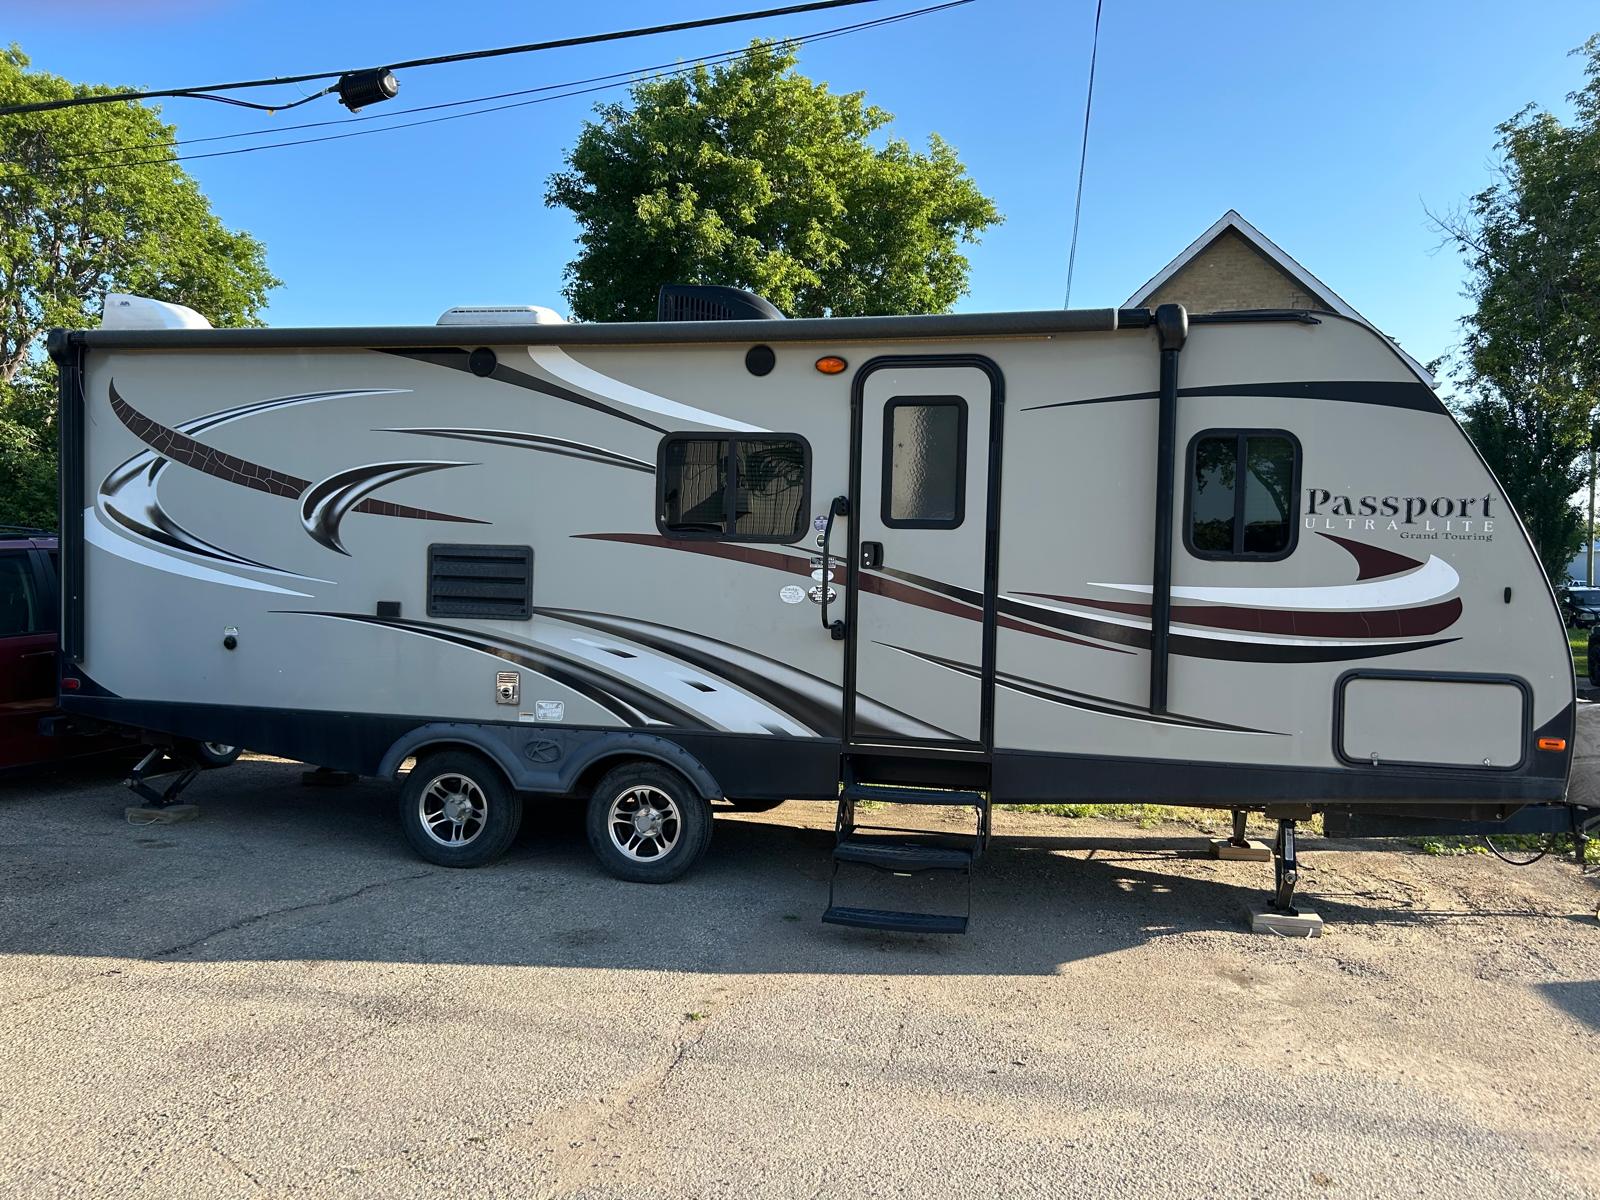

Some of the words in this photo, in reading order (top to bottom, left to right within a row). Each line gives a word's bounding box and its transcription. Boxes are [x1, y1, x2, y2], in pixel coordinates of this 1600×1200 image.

[1304, 488, 1497, 524] Passport
[1304, 518, 1398, 531] ULTRA
[1425, 520, 1495, 532] LITE
[1400, 531, 1438, 540] Grand
[1441, 532, 1494, 542] Touring
